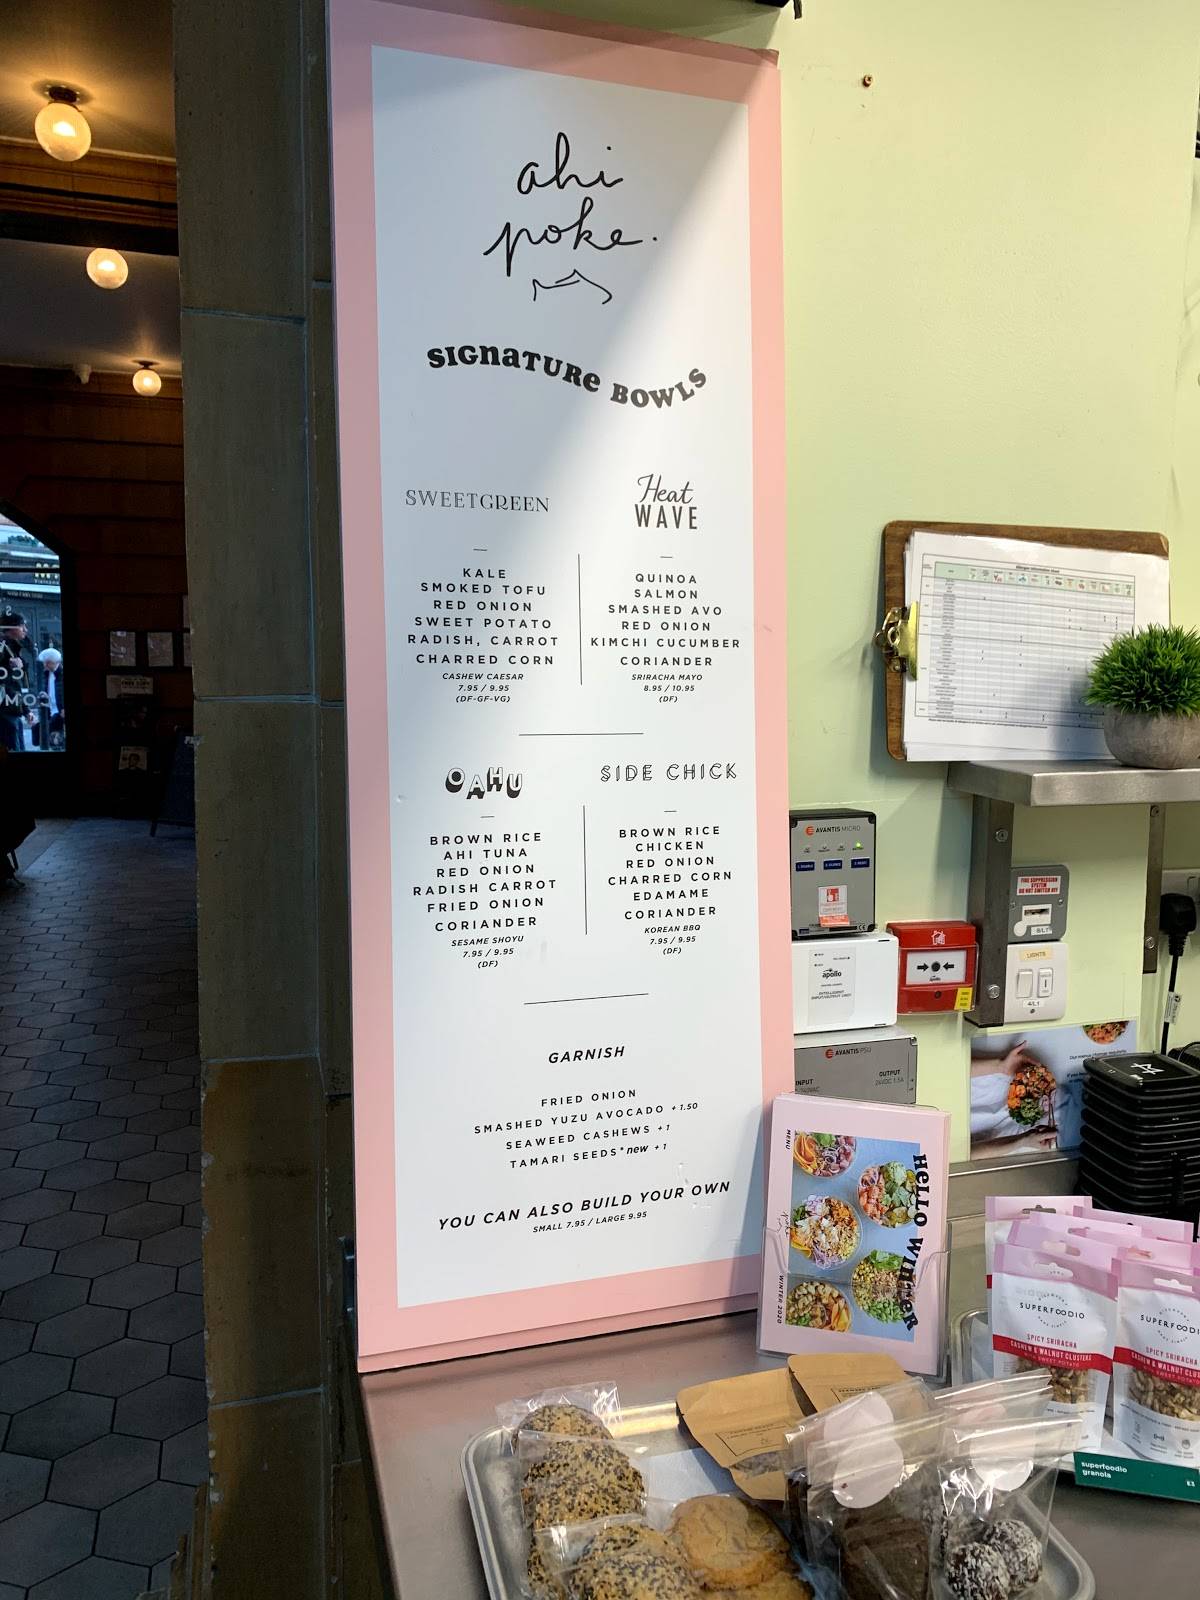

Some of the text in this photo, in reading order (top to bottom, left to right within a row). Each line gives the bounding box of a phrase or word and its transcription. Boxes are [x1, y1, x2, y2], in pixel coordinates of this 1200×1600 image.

[518, 132, 623, 194] ahi
[610, 368, 706, 409] BOWLS
[638, 474, 694, 504] Heat
[405, 490, 550, 512] SWEETGREEN
[634, 504, 698, 530] WAVE
[463, 568, 506, 579] KALE
[636, 574, 697, 584] QUINOA
[421, 582, 546, 595] SMOKED TOFU
[634, 589, 698, 599] SALMON
[434, 600, 532, 612] RED ONION
[608, 604, 722, 616] SMASHED AVO
[415, 617, 552, 629] SWEET POTATO
[622, 622, 710, 631] RED ONION
[408, 634, 558, 646] RADISH, CARROT
[592, 638, 740, 648] KIMCHI CUCUMBER
[416, 654, 554, 665] CHARRED CORN
[620, 656, 712, 666] CORIANDER
[456, 695, 511, 703] (DF-GF-VG)
[600, 762, 736, 782] SIDE CHICK
[445, 767, 522, 800] OAHU
[620, 826, 720, 838] BROWN RICE
[430, 832, 542, 846] BROWN RICE
[636, 841, 704, 852] CHICKEN
[444, 848, 528, 860] AHI TUNA
[626, 856, 714, 868] RED ONION
[436, 864, 535, 878] RED ONION
[608, 872, 732, 886] CHARRED CORN
[414, 880, 556, 896] RADISH CARROT
[634, 889, 708, 900] EDAMAME
[428, 898, 544, 912] FRIED ONION
[625, 906, 716, 920] CORIANDER
[436, 916, 536, 932] CORIANDER
[452, 936, 524, 946] SESAME SHOYU
[486, 949, 491, 957] /
[478, 960, 498, 968] (DF)
[822, 968, 842, 979] apollo
[549, 1046, 625, 1063] GARNISH
[542, 1090, 636, 1107] FRIED ONION
[474, 1118, 542, 1134] SMASHED
[551, 1114, 588, 1124] YUZU
[596, 1106, 664, 1121] AVOCADO
[680, 1102, 698, 1111] 1.50
[506, 1134, 574, 1150] SEAWEED
[584, 1126, 650, 1140] CASHEWS
[510, 1155, 565, 1168] TAMARI
[439, 1182, 730, 1230] YOU CAN ALSO BUILD YOUR OWN
[532, 1211, 647, 1233] SMALL 7.95 / LARGE 9.95
[1020, 1302, 1084, 1319] SUPERFOODIO
[1140, 1314, 1200, 1334] SUPERFOODI
[1027, 1334, 1076, 1348] SPICY SRIRACHA
[1010, 1340, 1032, 1352] CASHEW
[1040, 1348, 1064, 1358] WALNUT
[1146, 1346, 1198, 1365] SPICY SRIRACHA
[1158, 1362, 1184, 1375] WALNUT
[1082, 1461, 1128, 1473] superfoodio
[1082, 1470, 1112, 1479] granola
